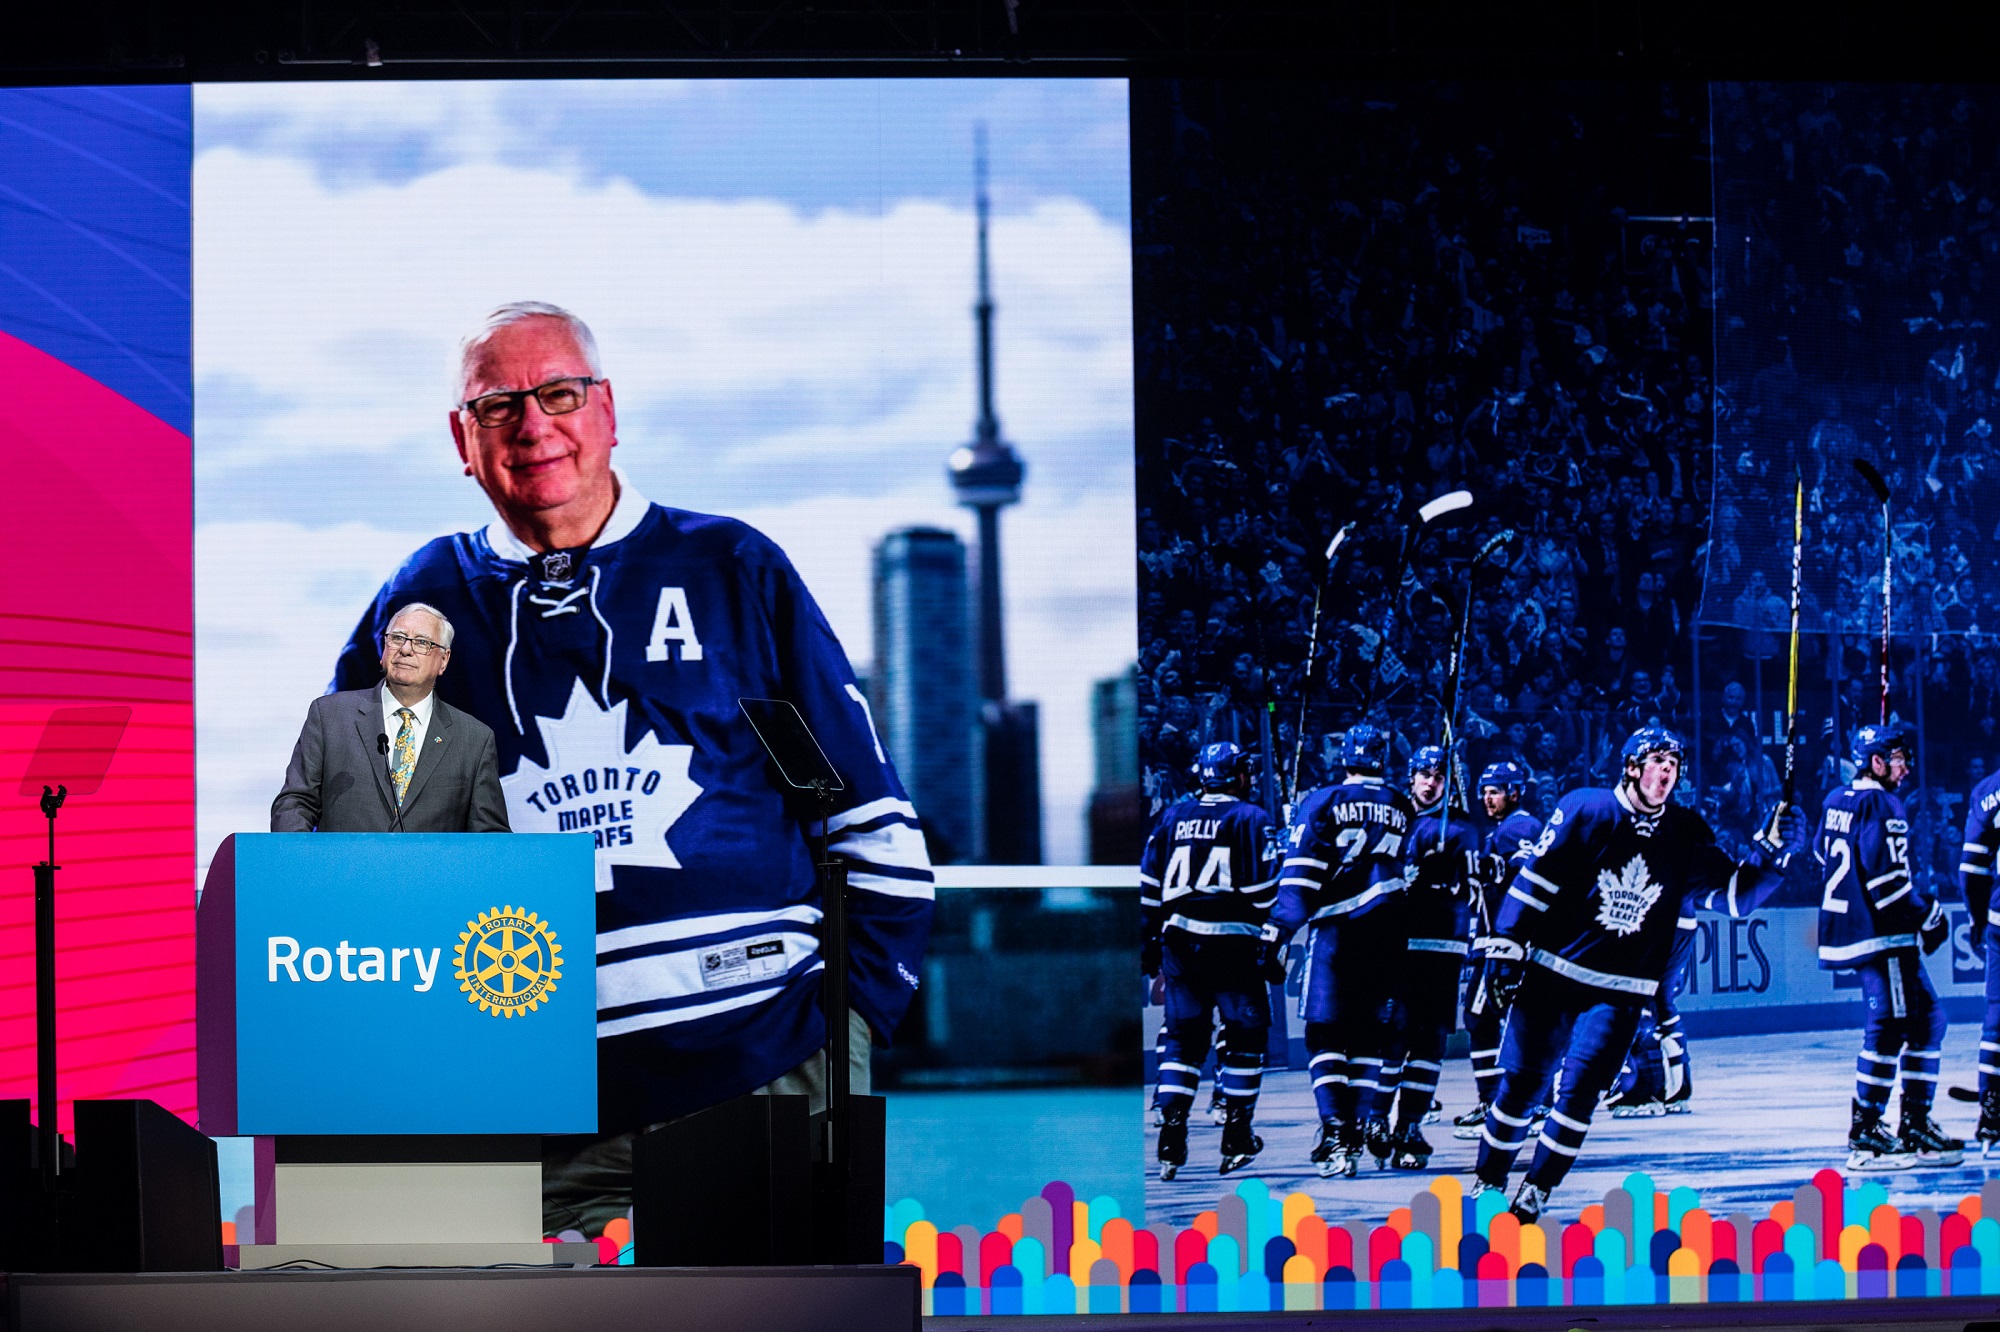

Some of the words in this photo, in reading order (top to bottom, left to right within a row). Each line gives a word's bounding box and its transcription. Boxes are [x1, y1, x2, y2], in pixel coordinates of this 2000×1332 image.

[646, 586, 704, 662] A
[526, 766, 661, 813] TORONTO
[558, 799, 634, 832] MAPLE
[577, 825, 634, 849] AFS
[1885, 836, 1909, 864] 12
[1161, 845, 1236, 903] 44
[1607, 889, 1650, 909] TORONTO
[1612, 900, 1641, 914] MAPLE
[484, 918, 532, 931] ROTARY
[1609, 909, 1638, 923] LEAFS
[266, 935, 442, 993] Rotary
[1688, 917, 1771, 995] PLES
[470, 977, 548, 1006] INTERNATIONAL
